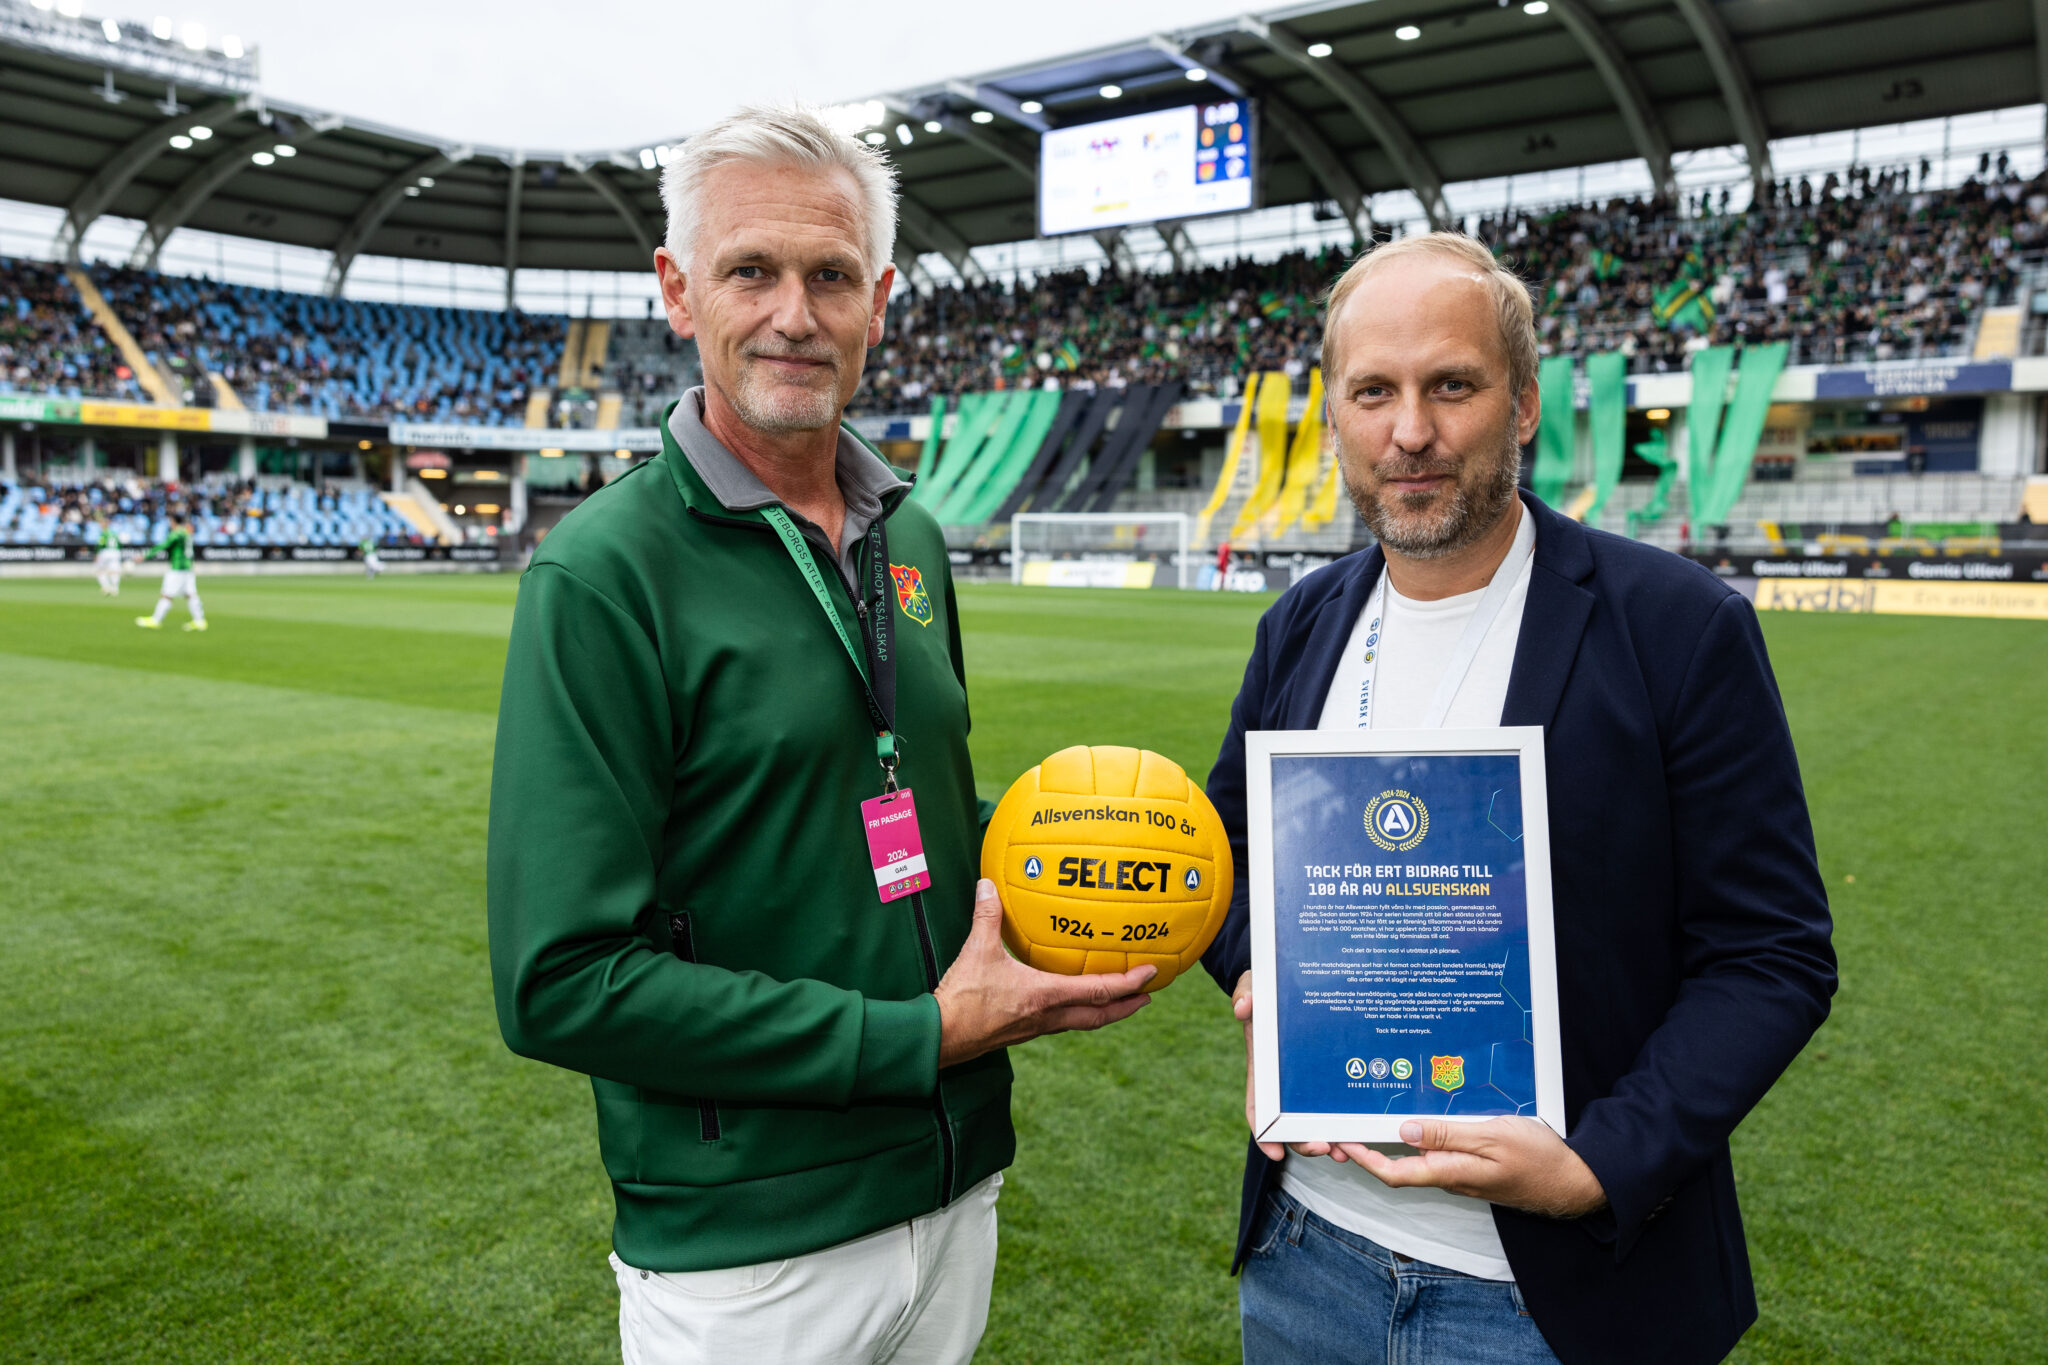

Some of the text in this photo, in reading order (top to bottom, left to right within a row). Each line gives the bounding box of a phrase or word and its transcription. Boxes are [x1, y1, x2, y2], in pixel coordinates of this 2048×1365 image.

[873, 550, 883, 558] &
[804, 562, 826, 598] ATLET-
[1359, 679, 1370, 719] SVENSK
[868, 809, 912, 830] FRI PASSAGE
[1031, 805, 1197, 837] Allsvenskan 100 år
[887, 848, 909, 862] 2024
[1058, 856, 1171, 893] SELECT
[1304, 863, 1493, 878] TACK FÖR ERT BIDRAG TILL
[1308, 881, 1490, 896] 100 ÅR AV ALLSVENSKAN
[1050, 915, 1095, 939] 1924
[1120, 921, 1170, 942] 2024
[1375, 998, 1383, 1006] sig
